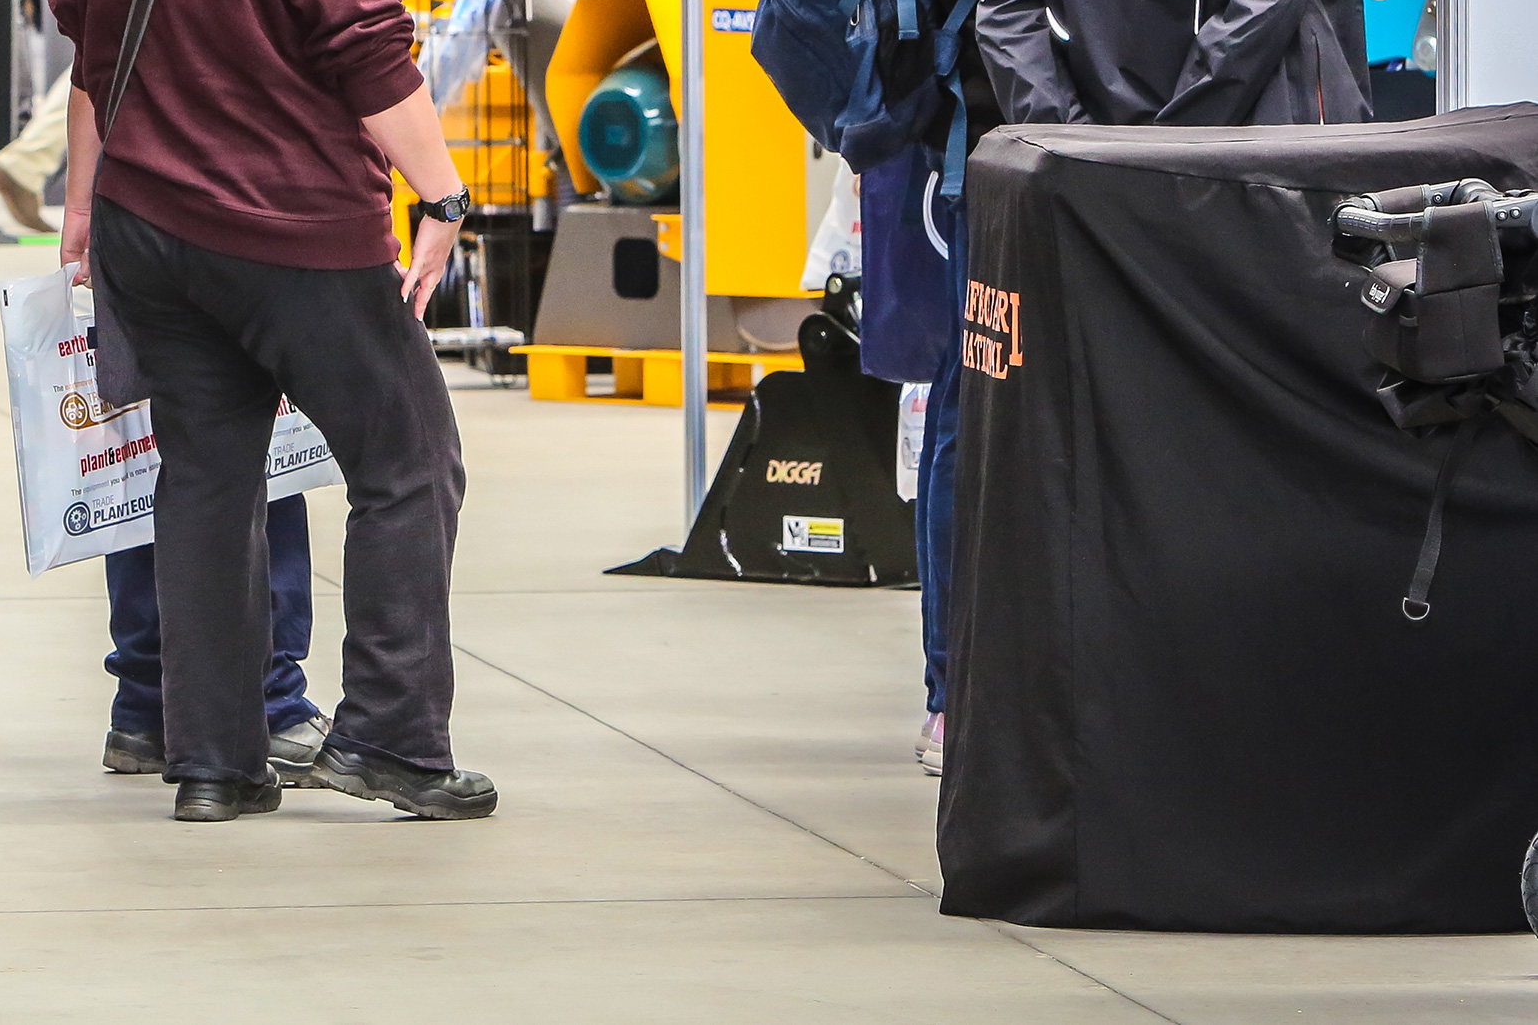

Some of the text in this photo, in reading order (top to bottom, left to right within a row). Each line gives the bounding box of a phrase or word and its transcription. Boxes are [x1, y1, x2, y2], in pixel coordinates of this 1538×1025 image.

[53, 383, 64, 393] The
[292, 426, 303, 435] you
[80, 433, 157, 477] plant&equipmen
[273, 443, 295, 456] TRADE
[274, 443, 331, 471] PLANTEQU
[71, 488, 83, 497] The
[135, 466, 148, 476] now
[766, 459, 823, 486] DIGGA
[92, 494, 115, 510] TRADE
[93, 493, 154, 524] PLANTEQU
